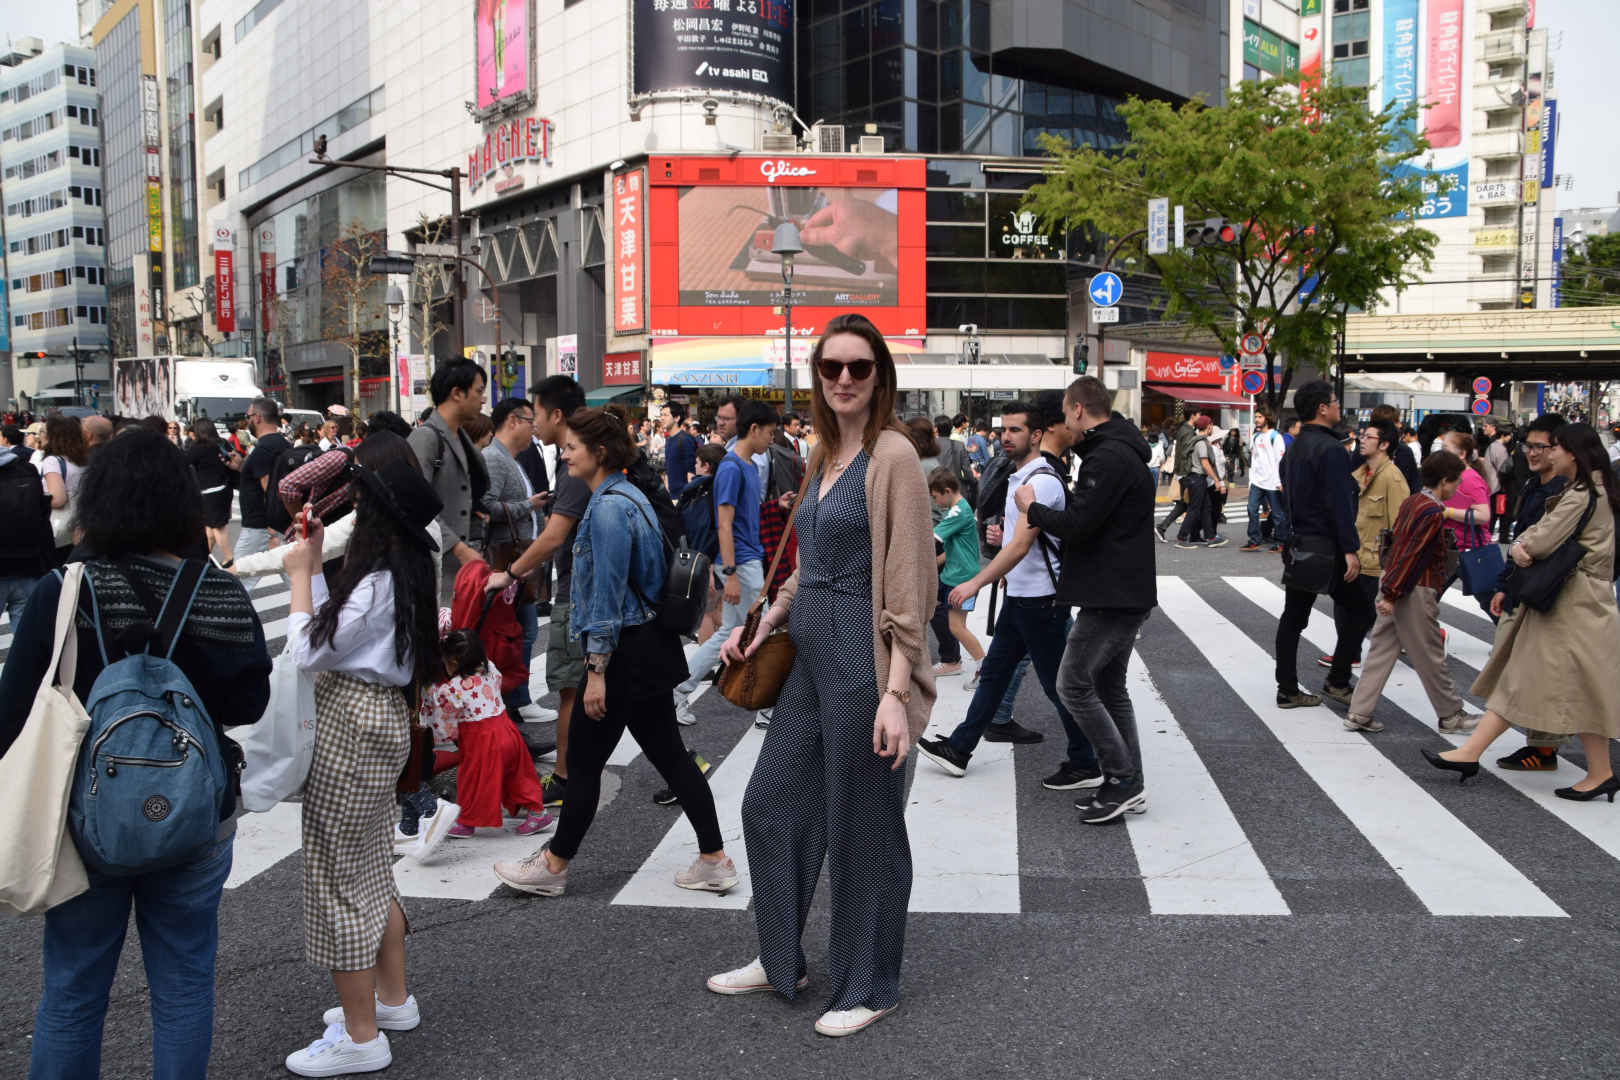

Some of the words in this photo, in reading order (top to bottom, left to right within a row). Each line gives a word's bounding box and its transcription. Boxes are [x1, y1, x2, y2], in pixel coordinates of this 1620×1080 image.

[673, 17, 723, 31] 松岡昌宏
[708, 66, 720, 77] tv
[722, 67, 750, 79] asahi
[468, 117, 551, 190] MAGNET
[761, 160, 816, 183] Glico
[1002, 234, 1049, 245] COFFEE
[619, 196, 637, 325] 天津甘栗
[605, 361, 640, 377] 天津甘栗
[672, 373, 738, 384] SANZENRI
